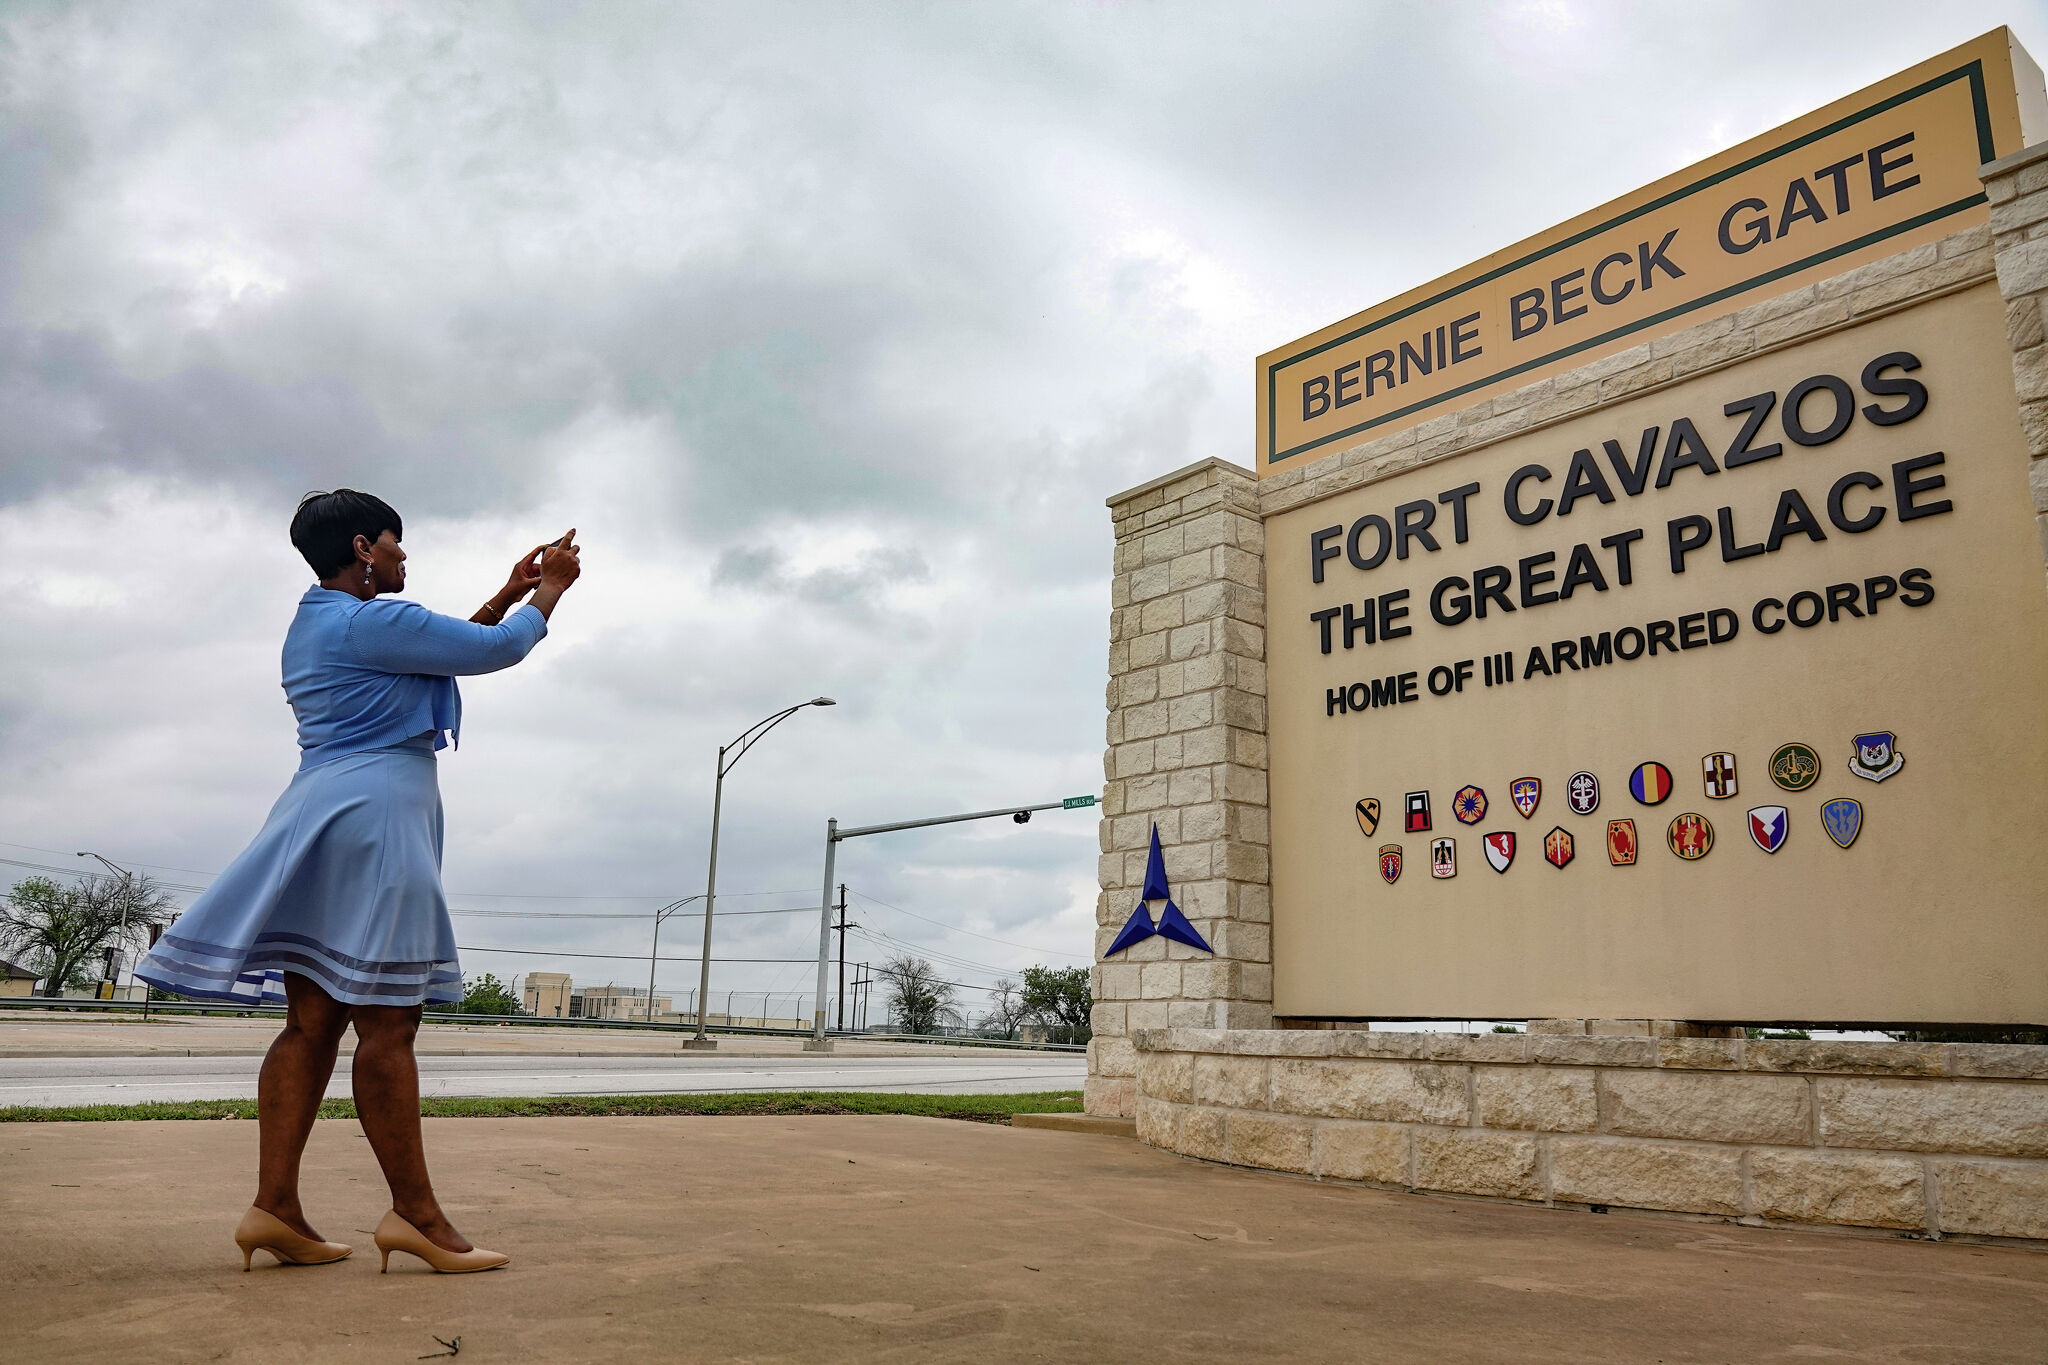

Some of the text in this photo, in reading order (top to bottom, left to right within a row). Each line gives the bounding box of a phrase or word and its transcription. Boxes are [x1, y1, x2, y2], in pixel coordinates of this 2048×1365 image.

[1302, 133, 1921, 420] BERNIE BECK GATE
[1310, 351, 1929, 584] FORT CAVAZOS
[1310, 452, 1954, 655] THE GREAT PLACE
[1326, 568, 1936, 717] HOME OF III ARMORED CORPS
